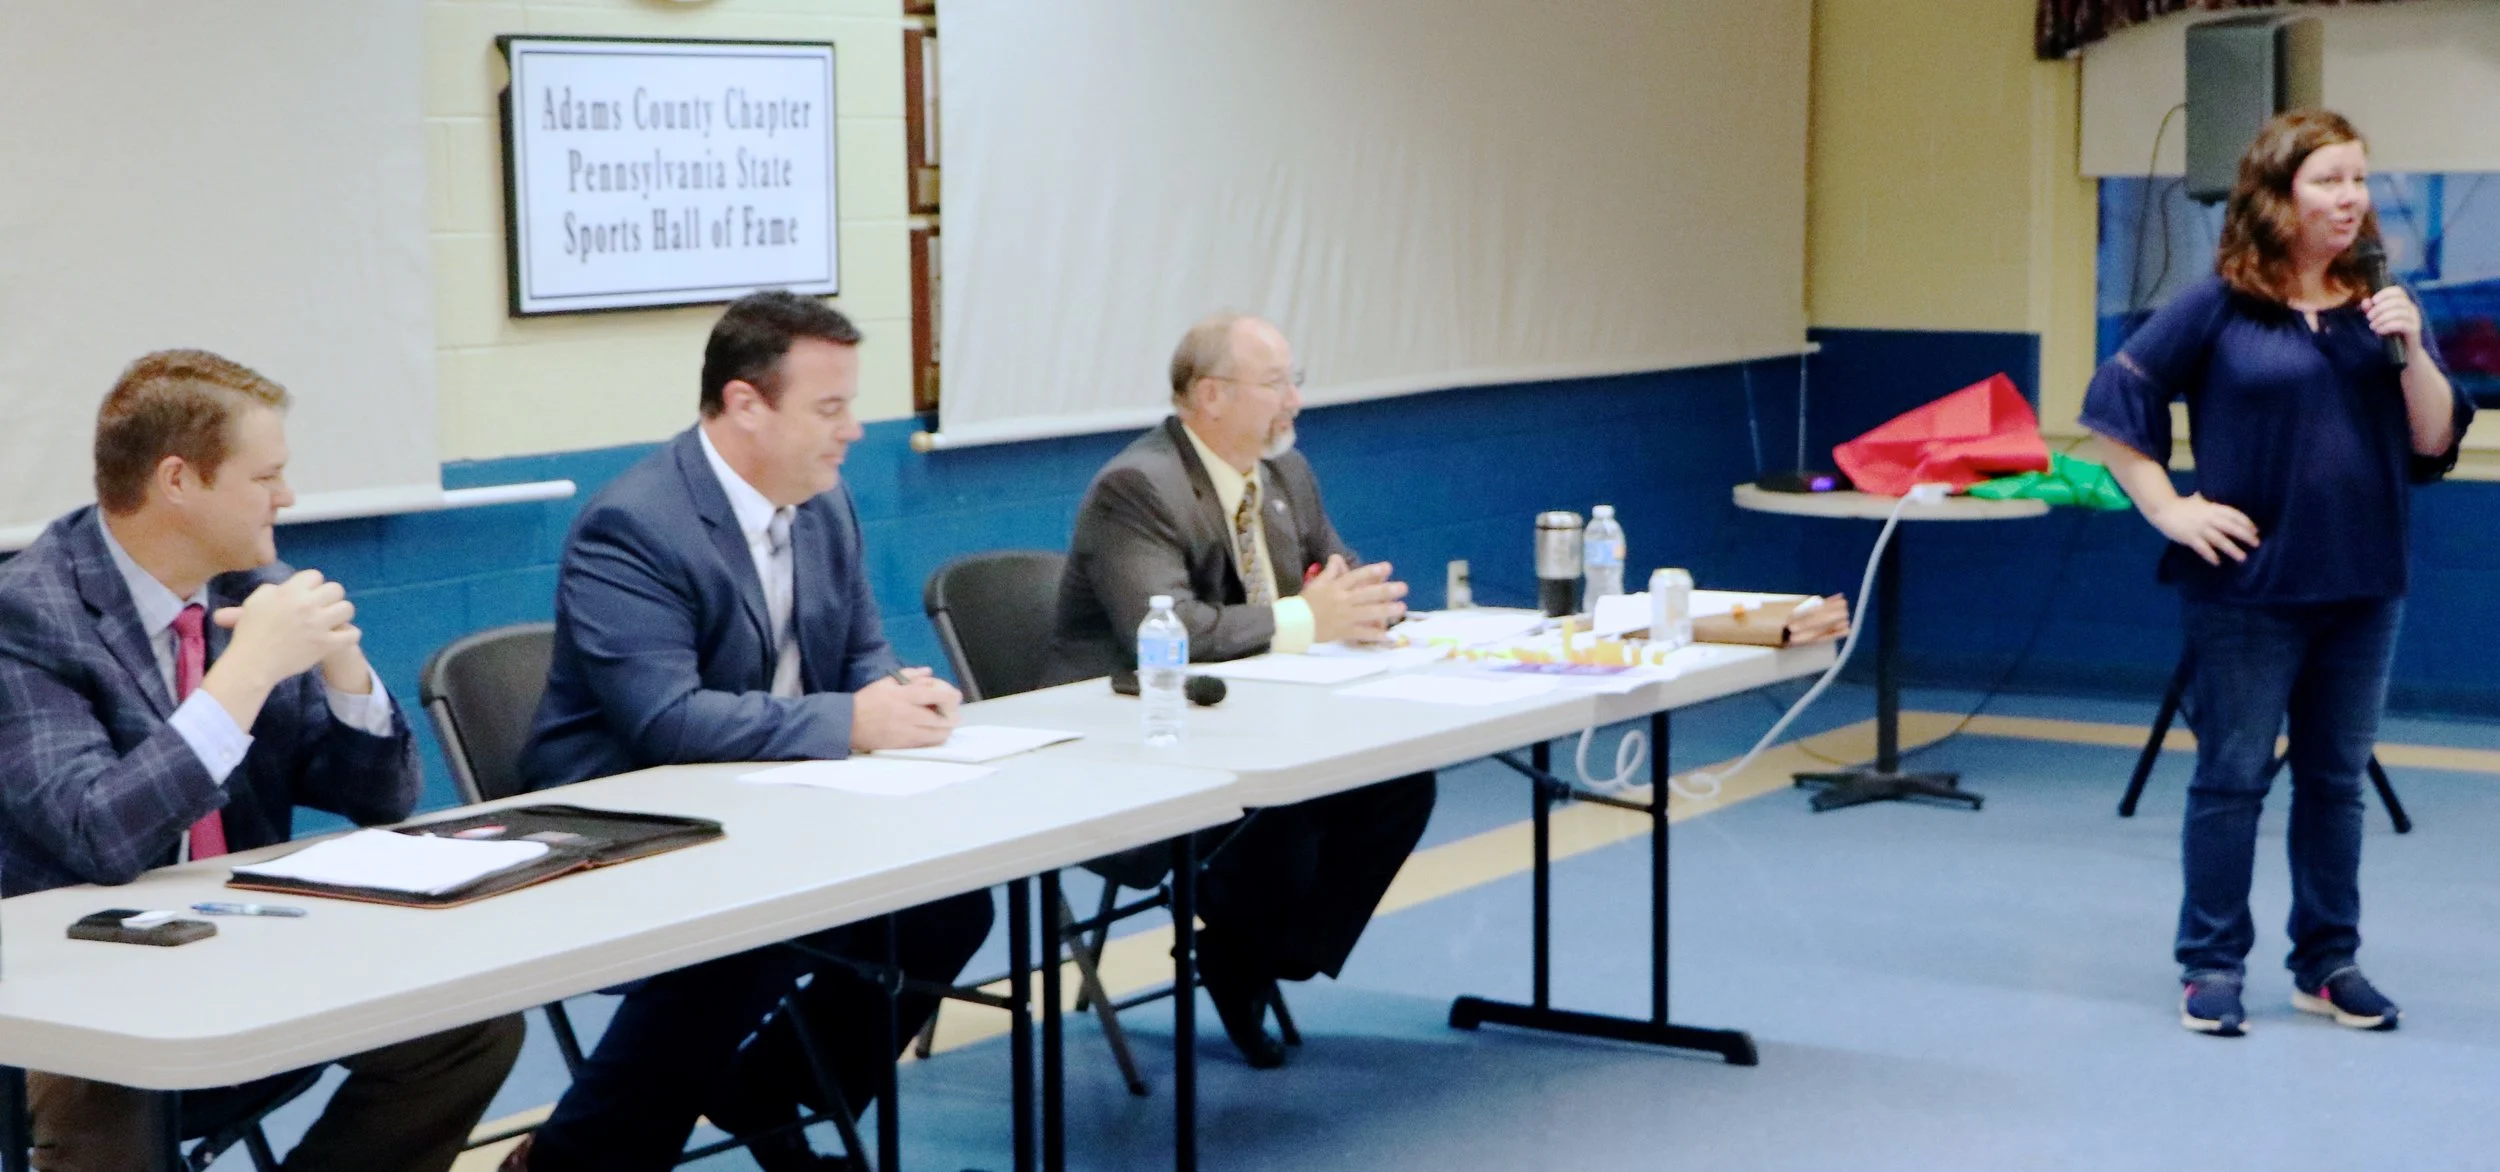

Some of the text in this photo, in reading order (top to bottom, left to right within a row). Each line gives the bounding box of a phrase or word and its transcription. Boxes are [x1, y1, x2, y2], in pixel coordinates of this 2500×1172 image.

[542, 86, 811, 138] Adams County Chapter
[568, 146, 792, 200] Pennsylvania State
[564, 205, 799, 263] Sports Hall of Fame
